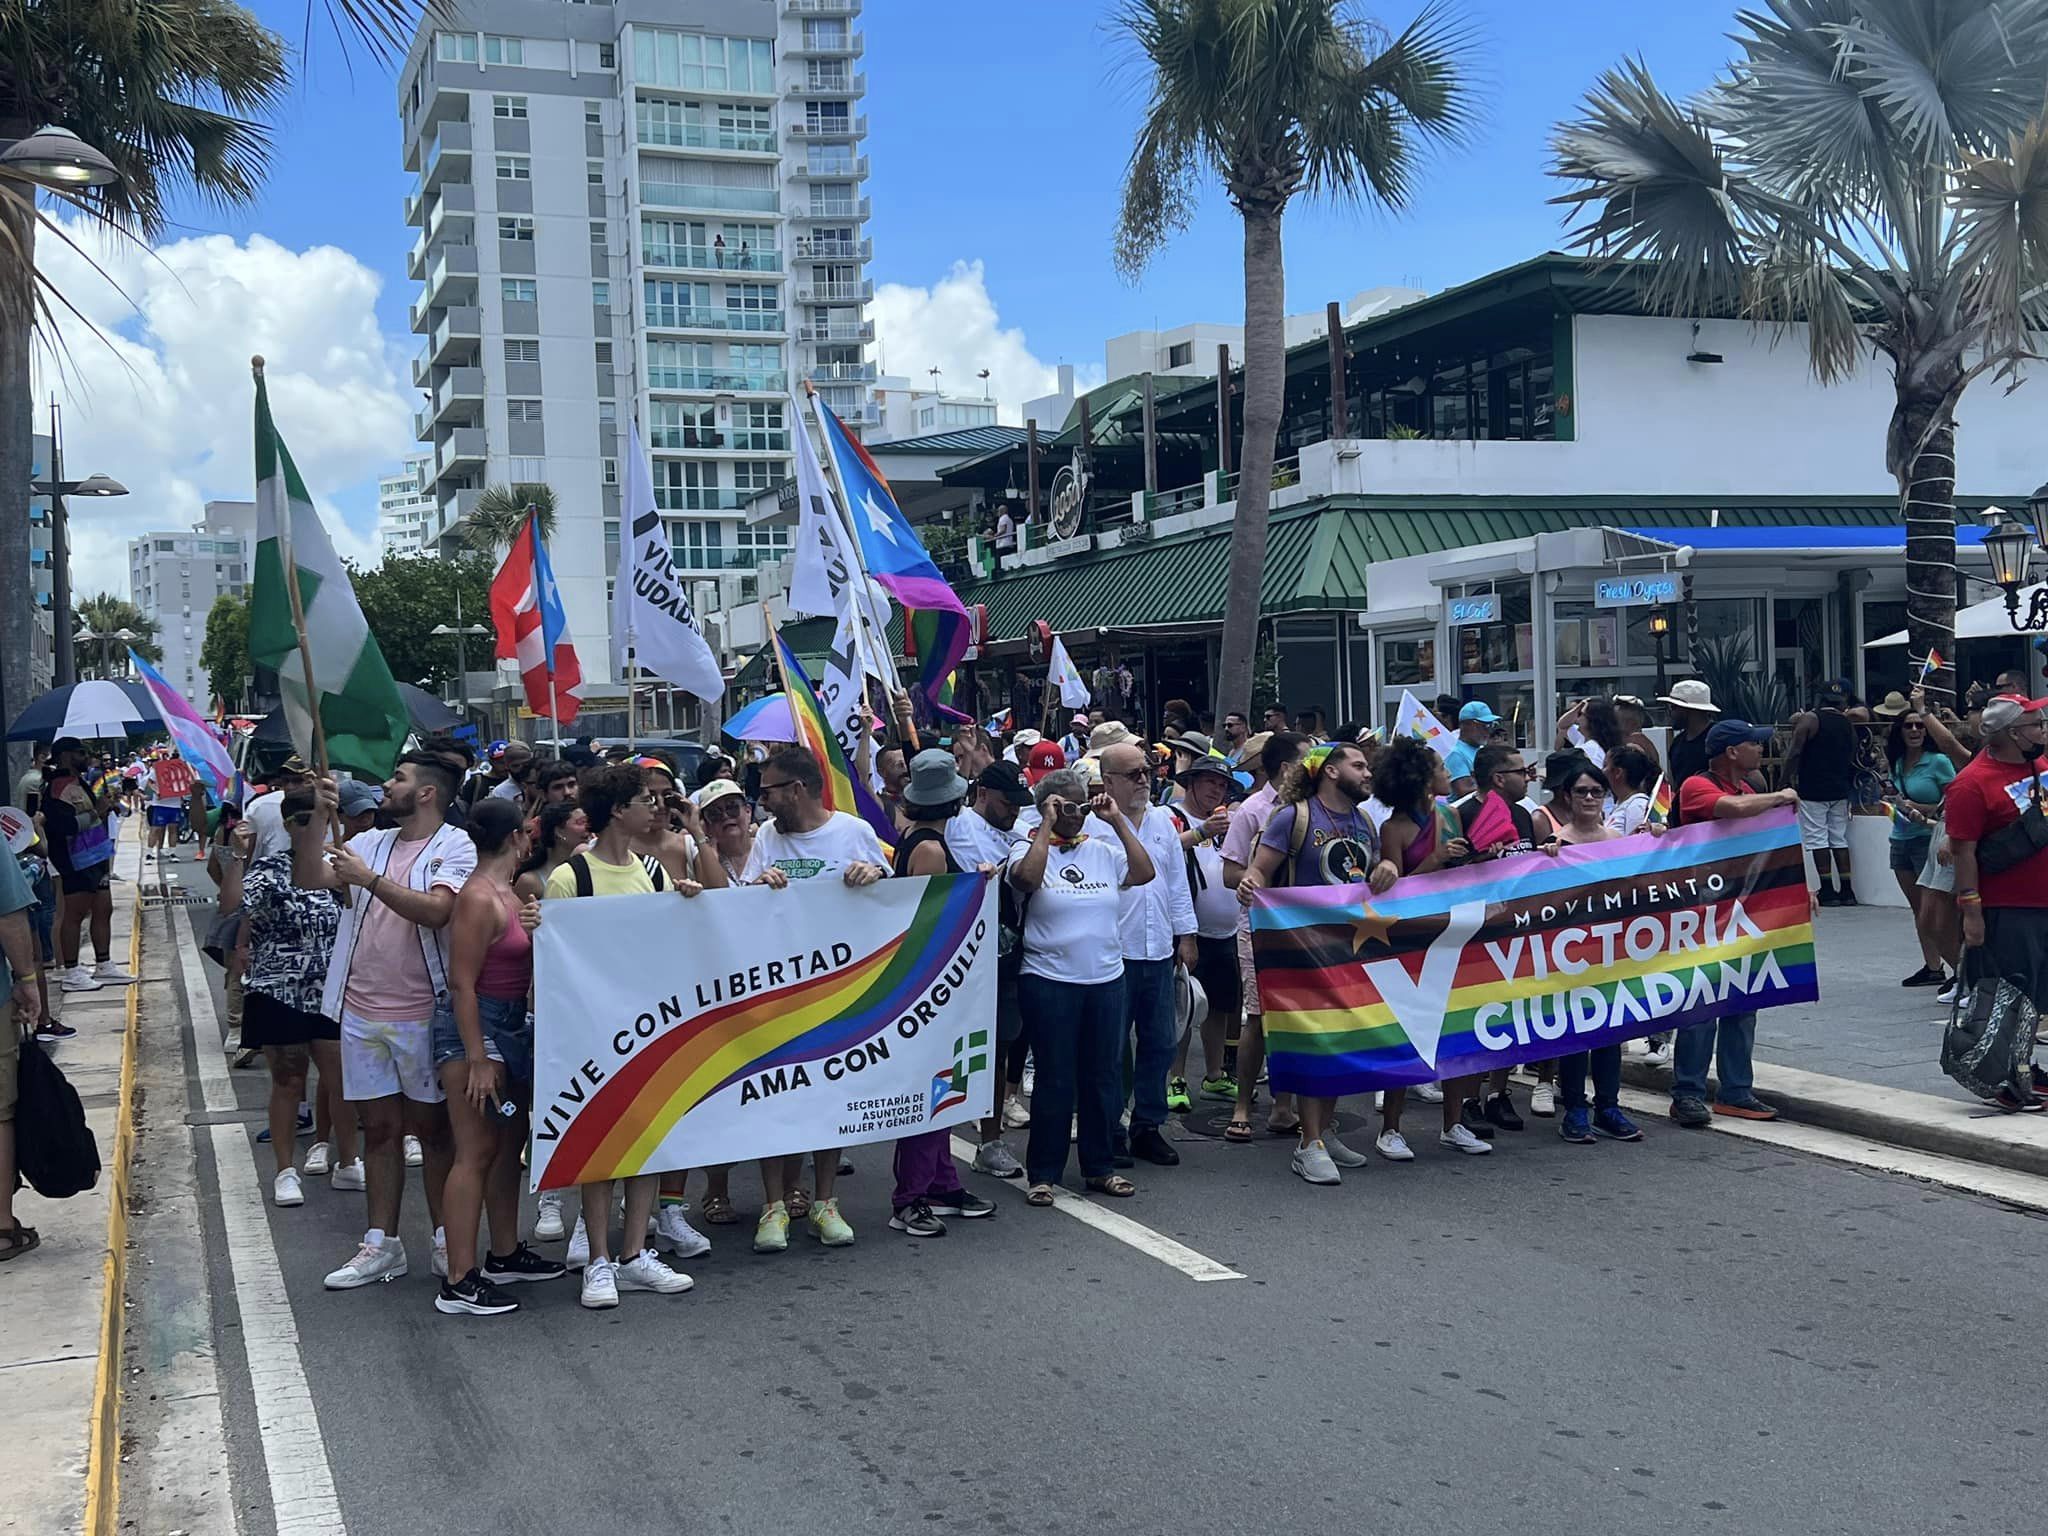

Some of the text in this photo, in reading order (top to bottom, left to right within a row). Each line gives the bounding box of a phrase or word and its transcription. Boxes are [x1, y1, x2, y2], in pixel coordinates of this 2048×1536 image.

[1599, 582, 1632, 600] Fresh
[1514, 873, 1725, 928] MOVIMIENTO
[1485, 899, 1765, 985] VICTORIA
[740, 919, 986, 1106] AMA CON ORGULLO
[1473, 951, 1788, 1052] CIUDADANA
[537, 942, 852, 1142] VIVE CON LIBERTAD
[839, 1114, 924, 1135] MUJER Y GÉNERO
[847, 1093, 924, 1111] SECRETARÍA DE
[862, 1103, 924, 1120] ASUNTOS DE
